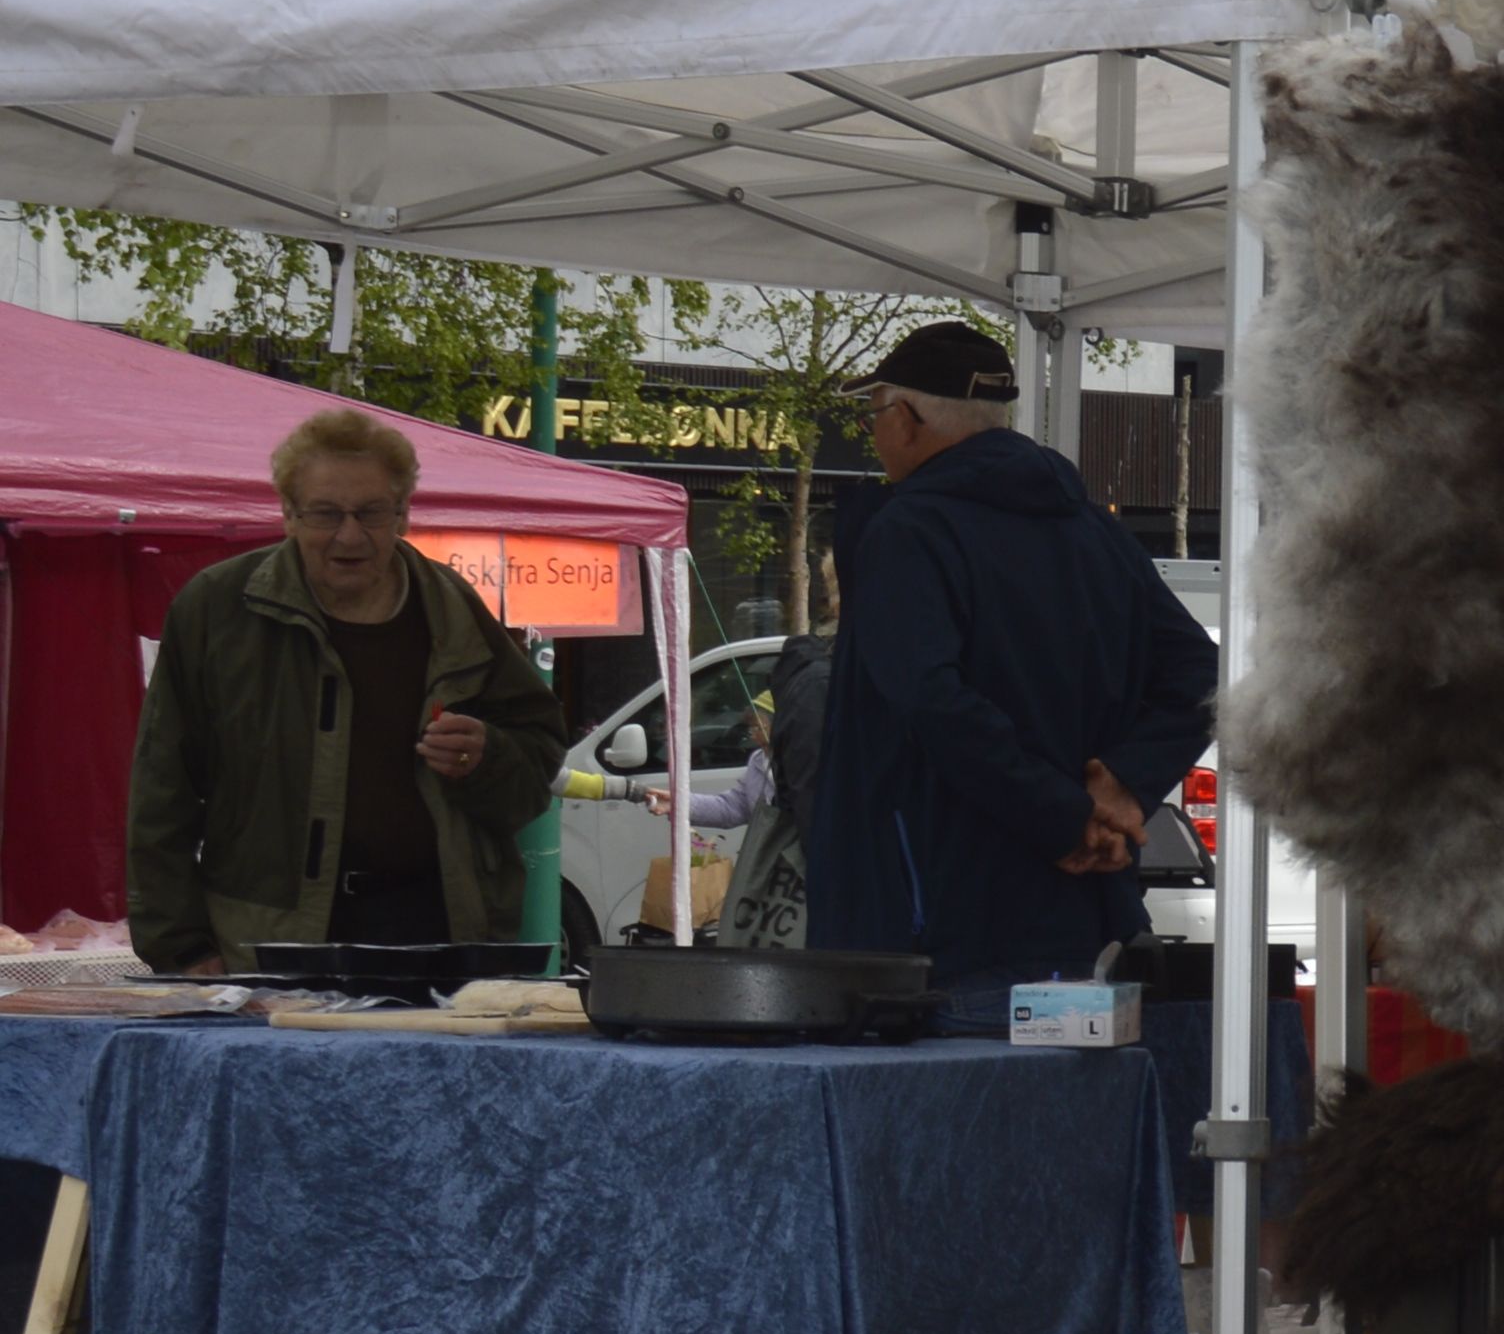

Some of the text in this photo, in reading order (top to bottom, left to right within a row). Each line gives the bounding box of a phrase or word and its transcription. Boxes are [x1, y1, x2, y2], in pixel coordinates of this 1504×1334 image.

[508, 556, 538, 584] fra
[546, 557, 613, 591] Senja
[1089, 1020, 1099, 1036] L
